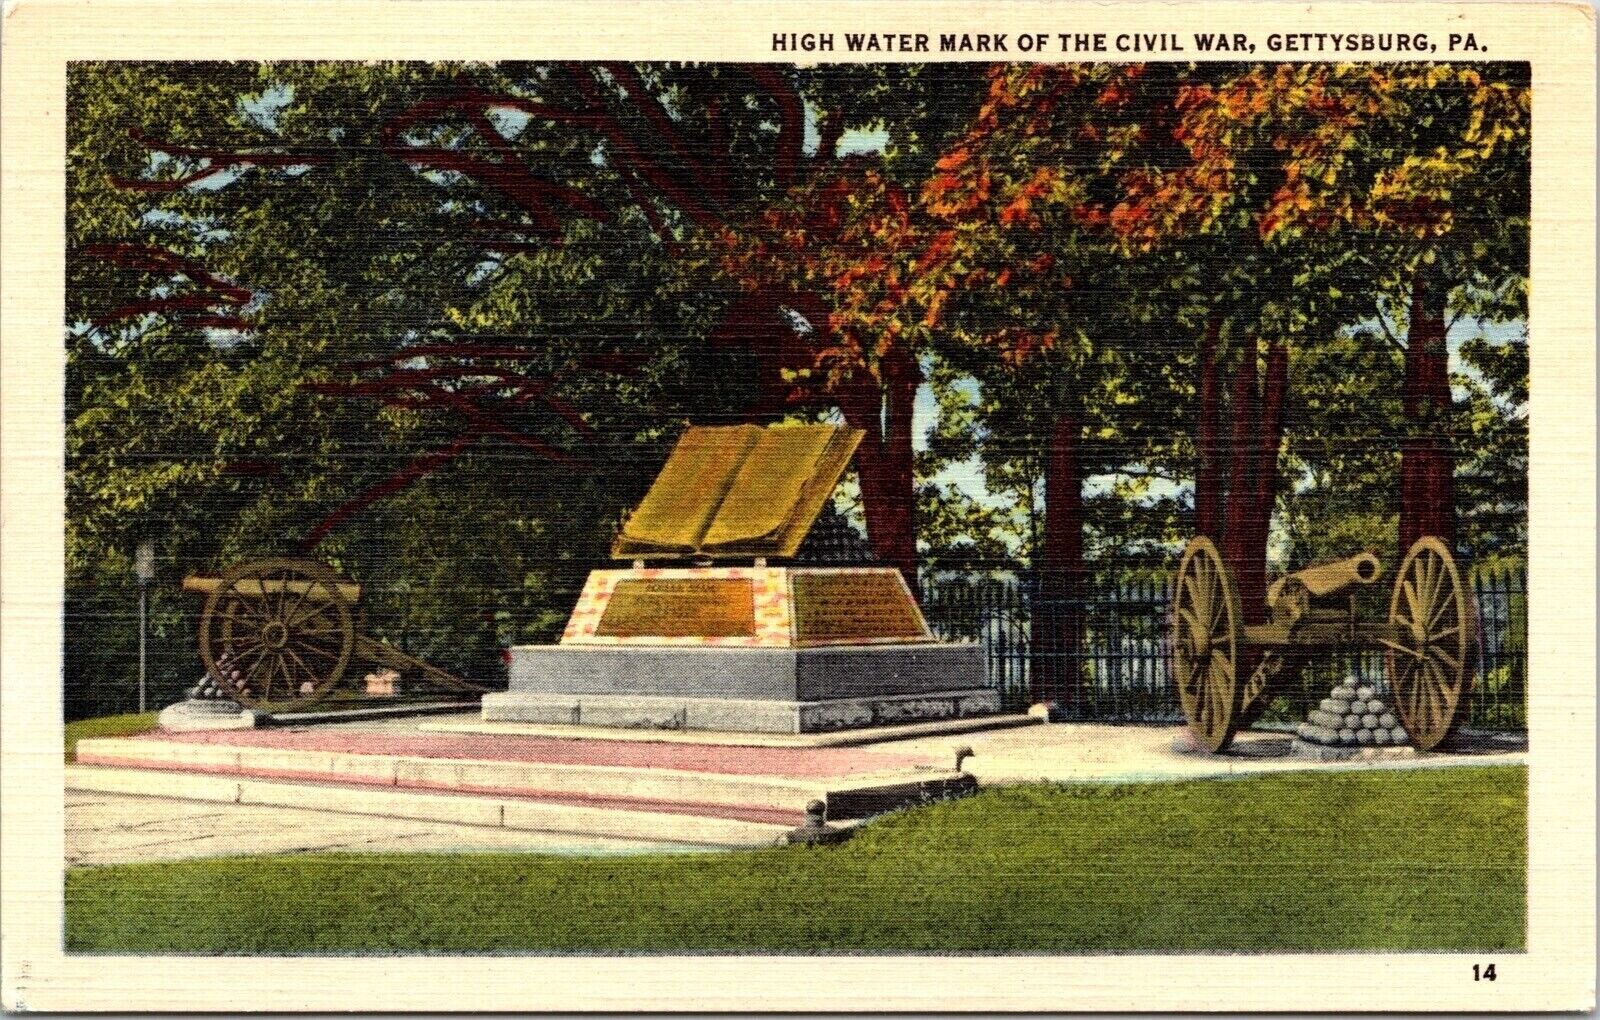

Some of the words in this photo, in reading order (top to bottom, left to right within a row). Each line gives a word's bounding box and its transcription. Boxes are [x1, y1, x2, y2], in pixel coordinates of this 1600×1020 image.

[772, 34, 834, 52] HIGH
[845, 34, 930, 52] WATER
[940, 34, 1008, 52] MARK
[1017, 34, 1050, 52] OF
[1059, 34, 1107, 52] THE
[1116, 34, 1184, 52] CIVIL
[1194, 34, 1256, 55] WAR,
[1267, 34, 1437, 54] GETTYSBURG,
[1448, 33, 1488, 53] PA.
[1472, 963, 1497, 982] 14
